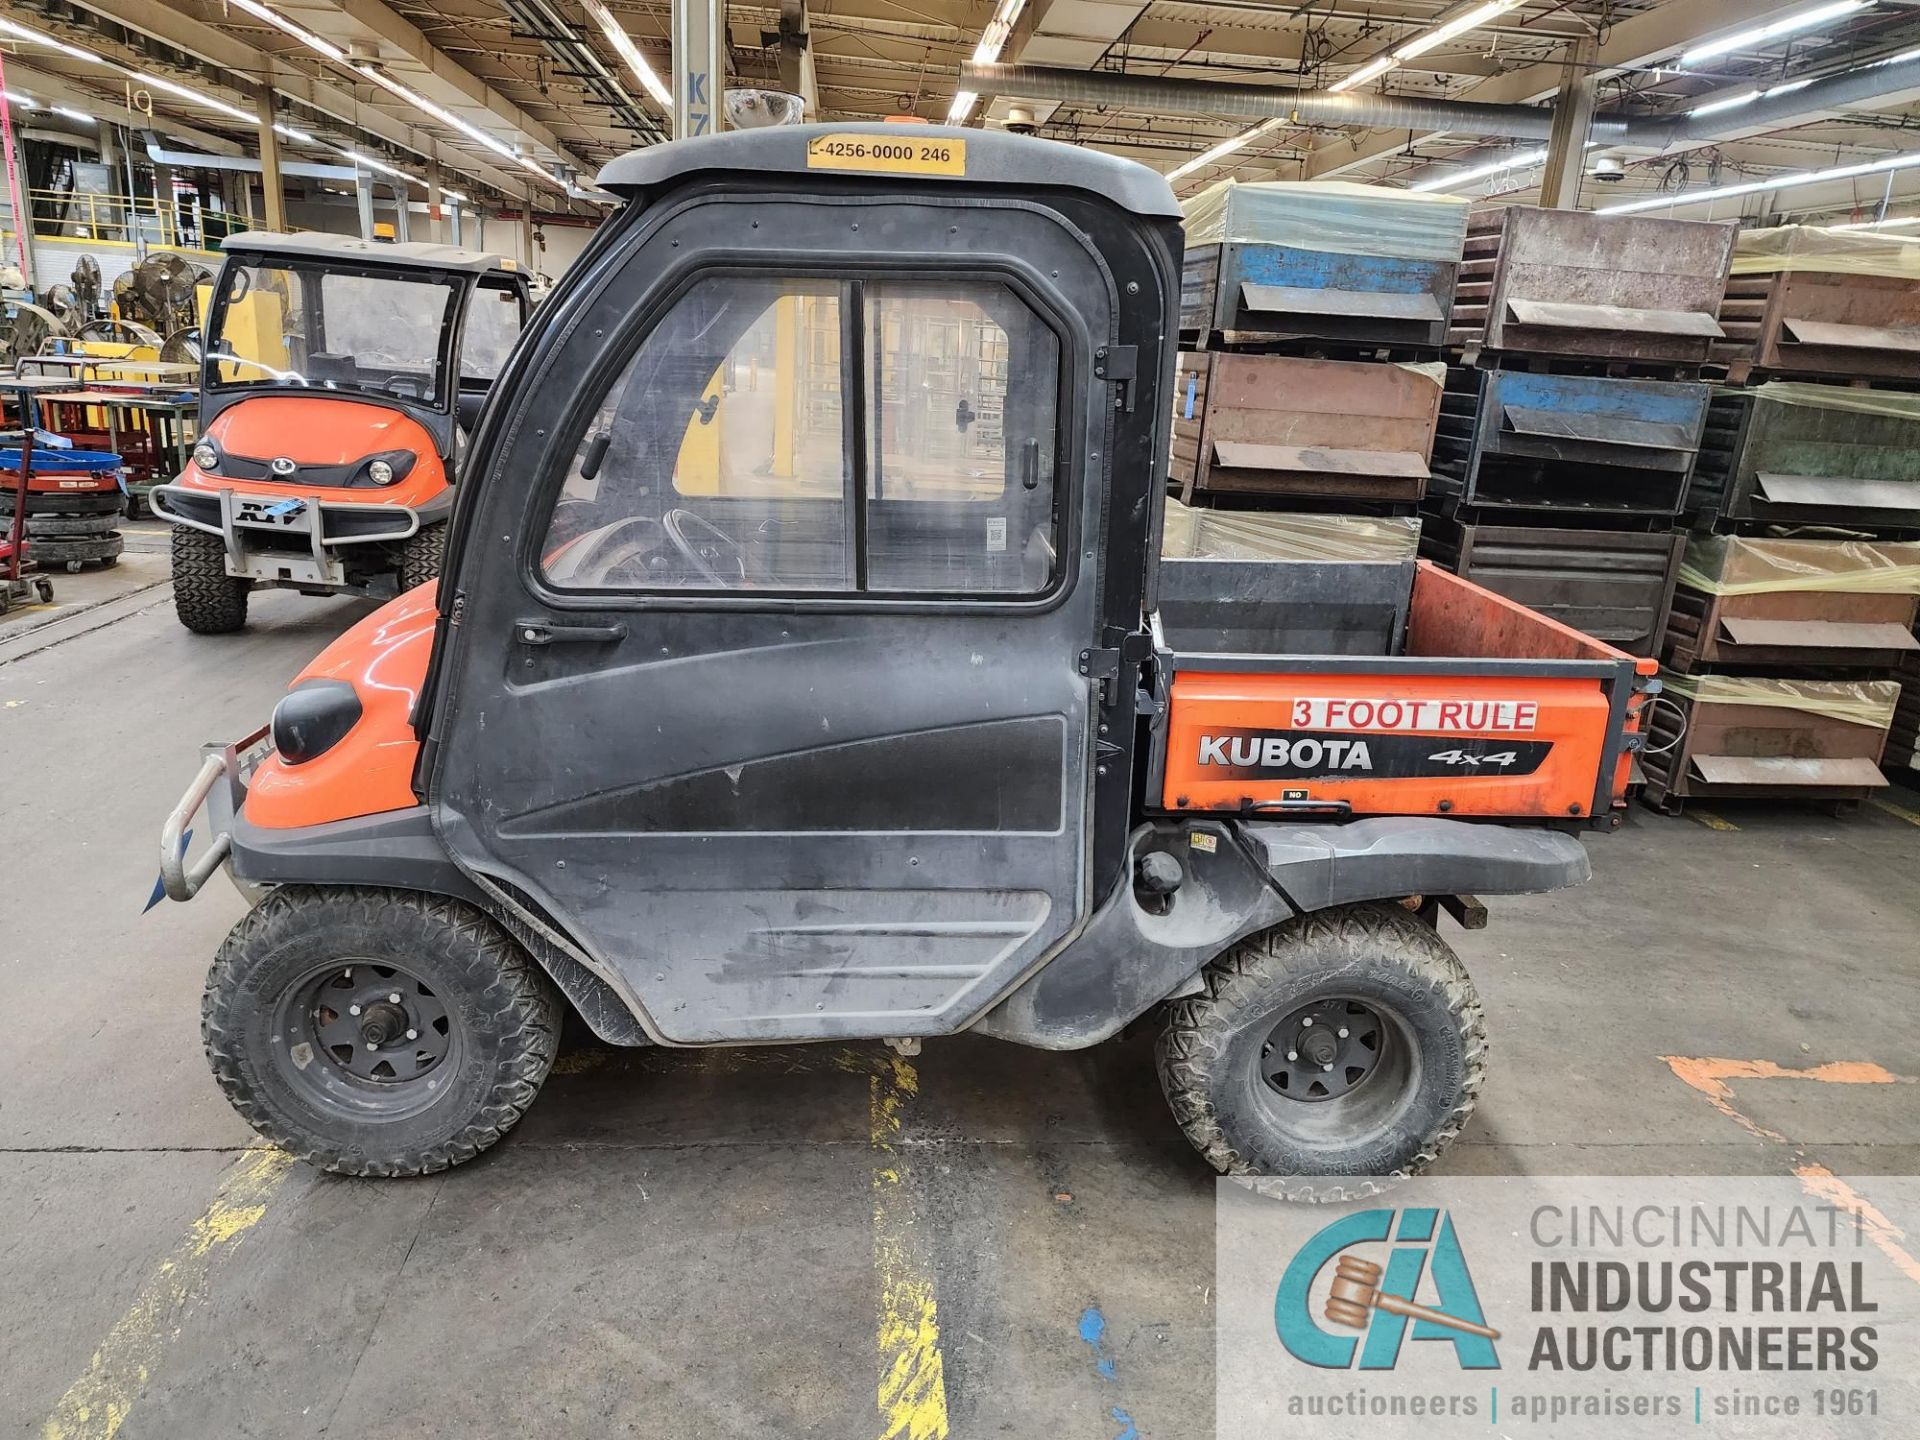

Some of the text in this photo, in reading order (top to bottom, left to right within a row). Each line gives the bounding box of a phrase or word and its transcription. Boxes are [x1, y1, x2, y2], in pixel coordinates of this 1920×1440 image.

[920, 147, 951, 162] 246
[1293, 700, 1537, 730] 3 FOOT RULE
[1198, 735, 1373, 770] KUBOTA
[1289, 791, 1302, 799] NO
